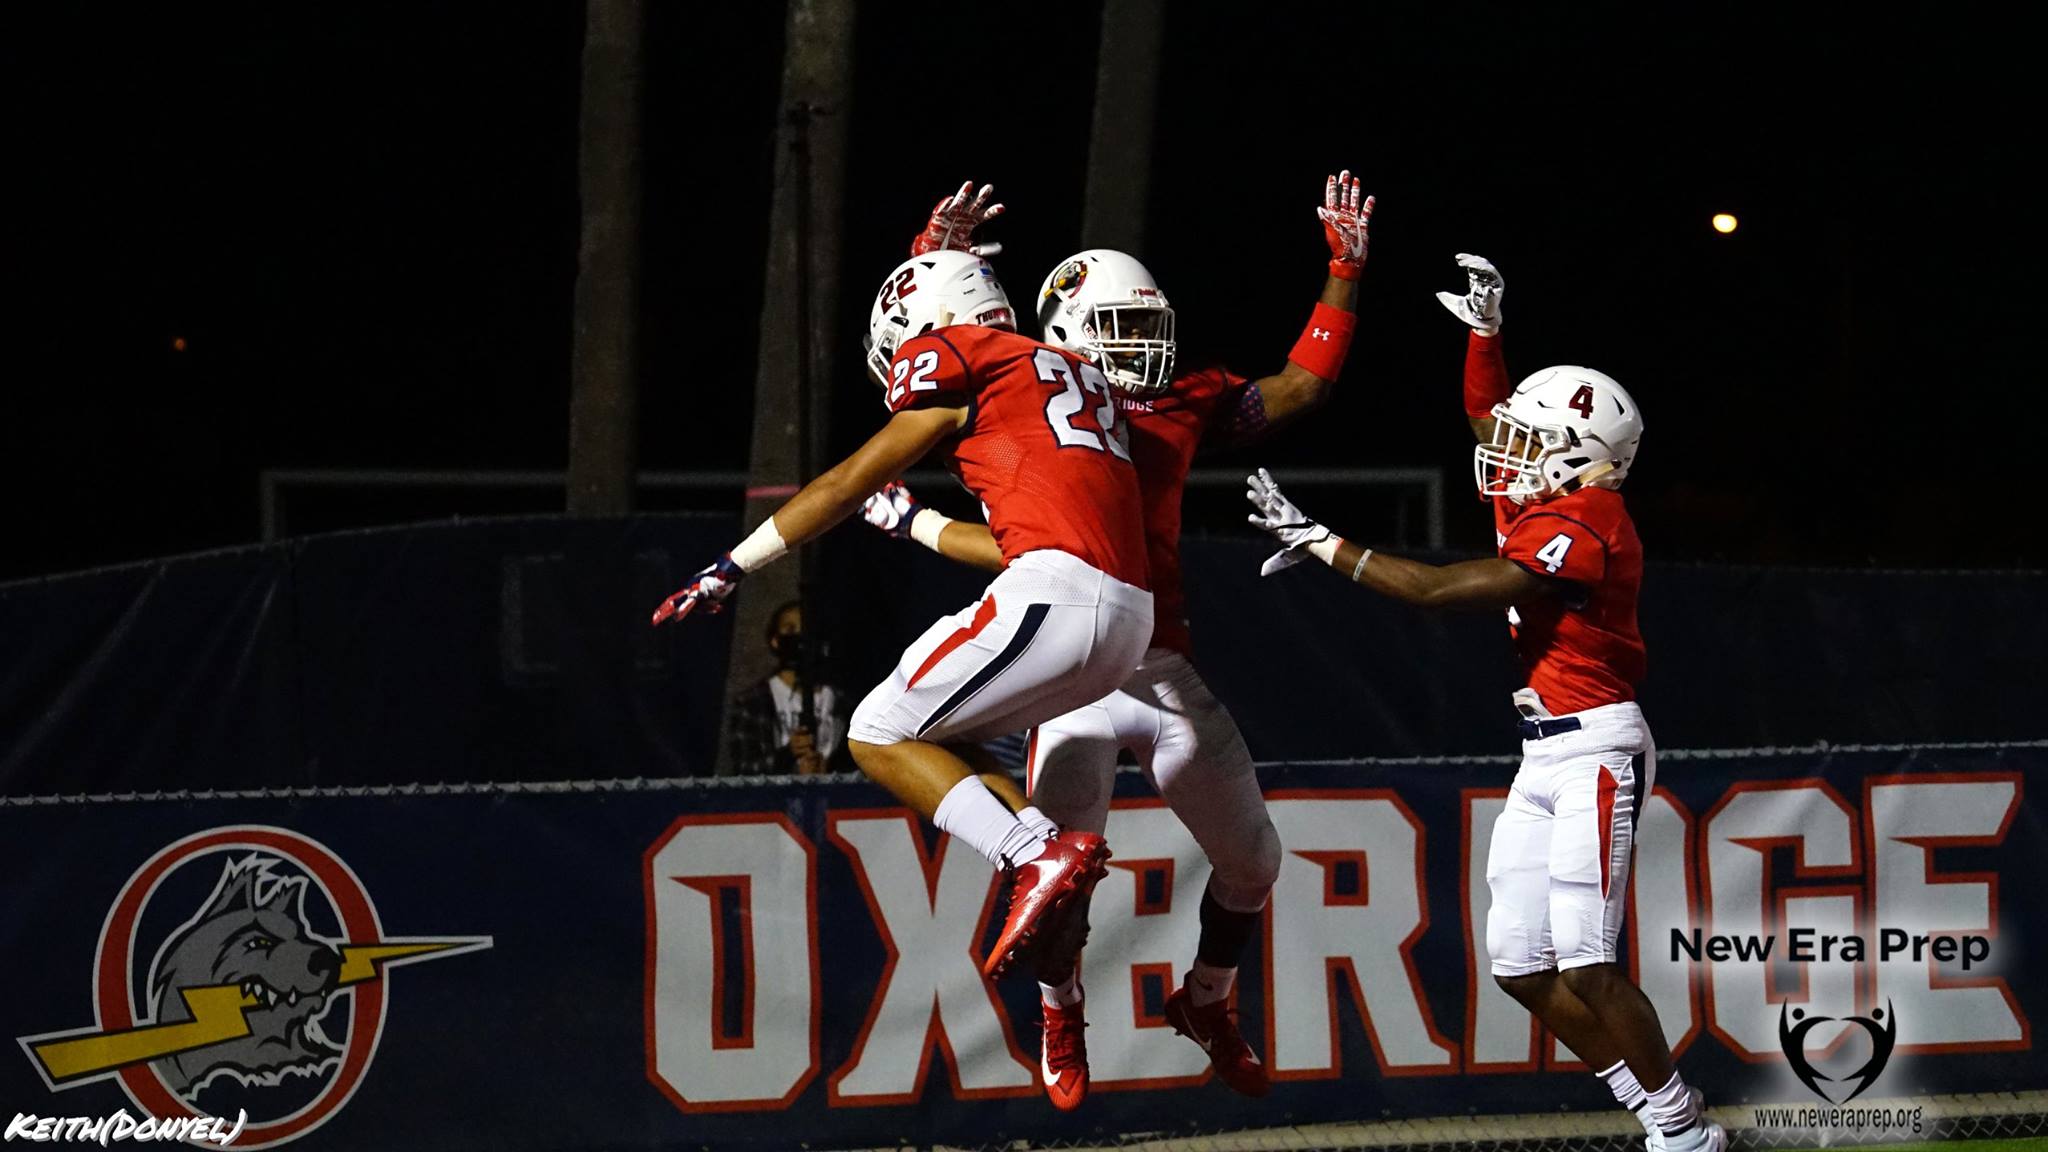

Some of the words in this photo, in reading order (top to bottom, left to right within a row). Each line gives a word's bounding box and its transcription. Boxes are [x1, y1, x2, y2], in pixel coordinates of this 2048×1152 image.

[880, 267, 918, 315] 22
[889, 350, 939, 405] 22
[1032, 347, 1133, 464] 22
[1568, 384, 1595, 420] 4
[1536, 532, 1573, 574] 4
